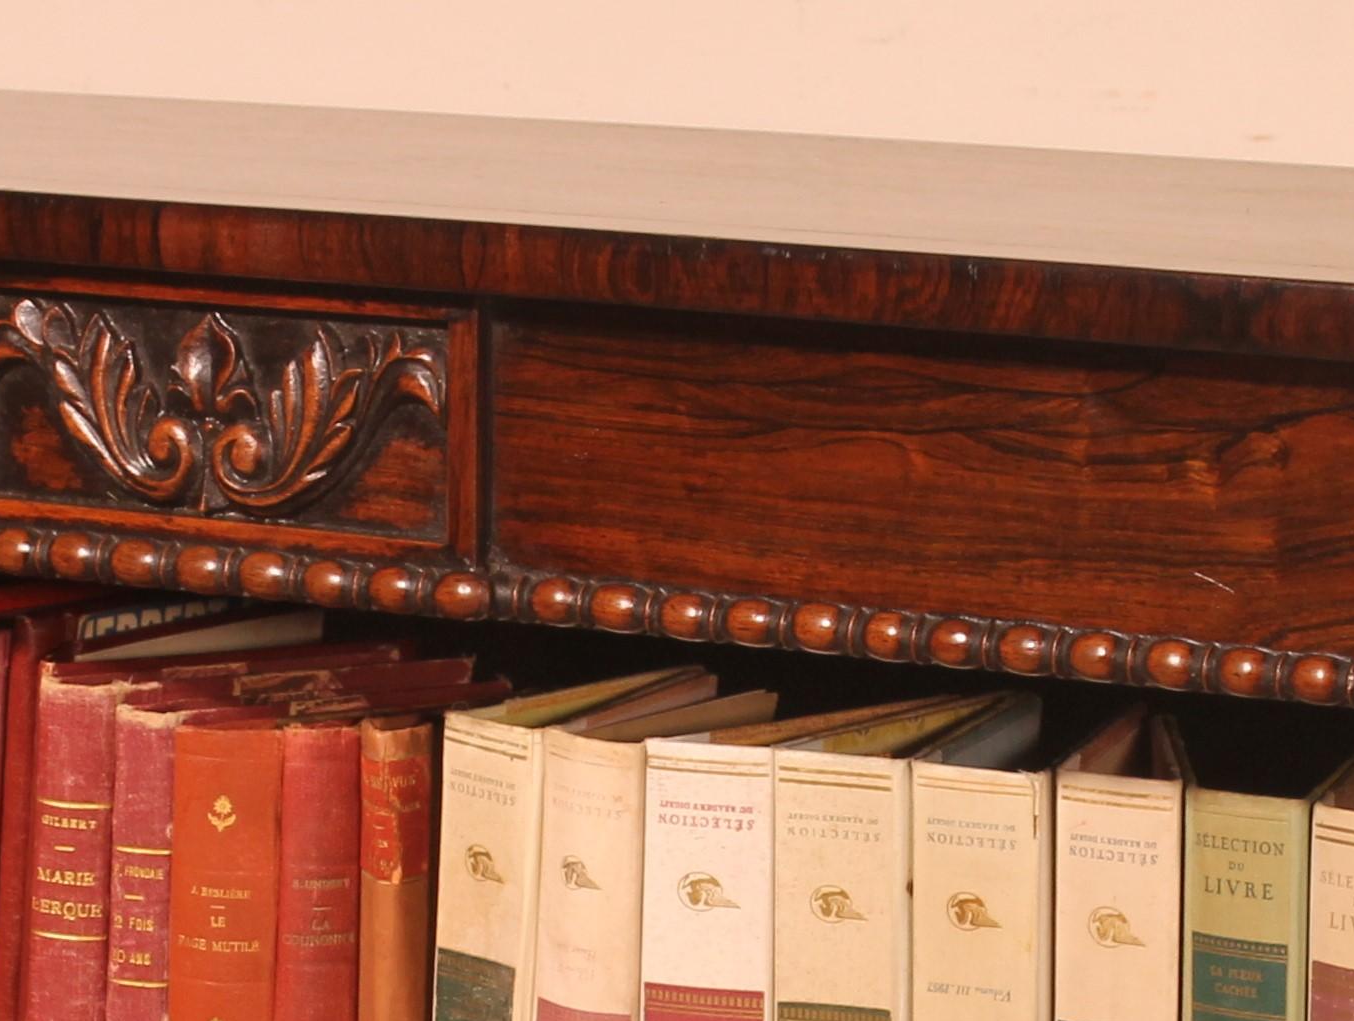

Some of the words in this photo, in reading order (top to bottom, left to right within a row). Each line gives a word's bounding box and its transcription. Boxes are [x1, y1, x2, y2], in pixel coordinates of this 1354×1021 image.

[739, 805, 754, 815] DU
[41, 815, 97, 830] GILBERT
[657, 812, 755, 833] SÉLECTION
[787, 826, 882, 843] SÉLECTION
[925, 830, 1017, 851] SÉLECTION
[1195, 831, 1285, 857] SÉLECTION
[1068, 845, 1159, 866] SÉLECTION
[1228, 860, 1245, 872] DU
[37, 867, 96, 887] MARIE
[1204, 875, 1274, 901] LIVRE
[129, 916, 154, 932] FOIS
[210, 915, 226, 929] LE
